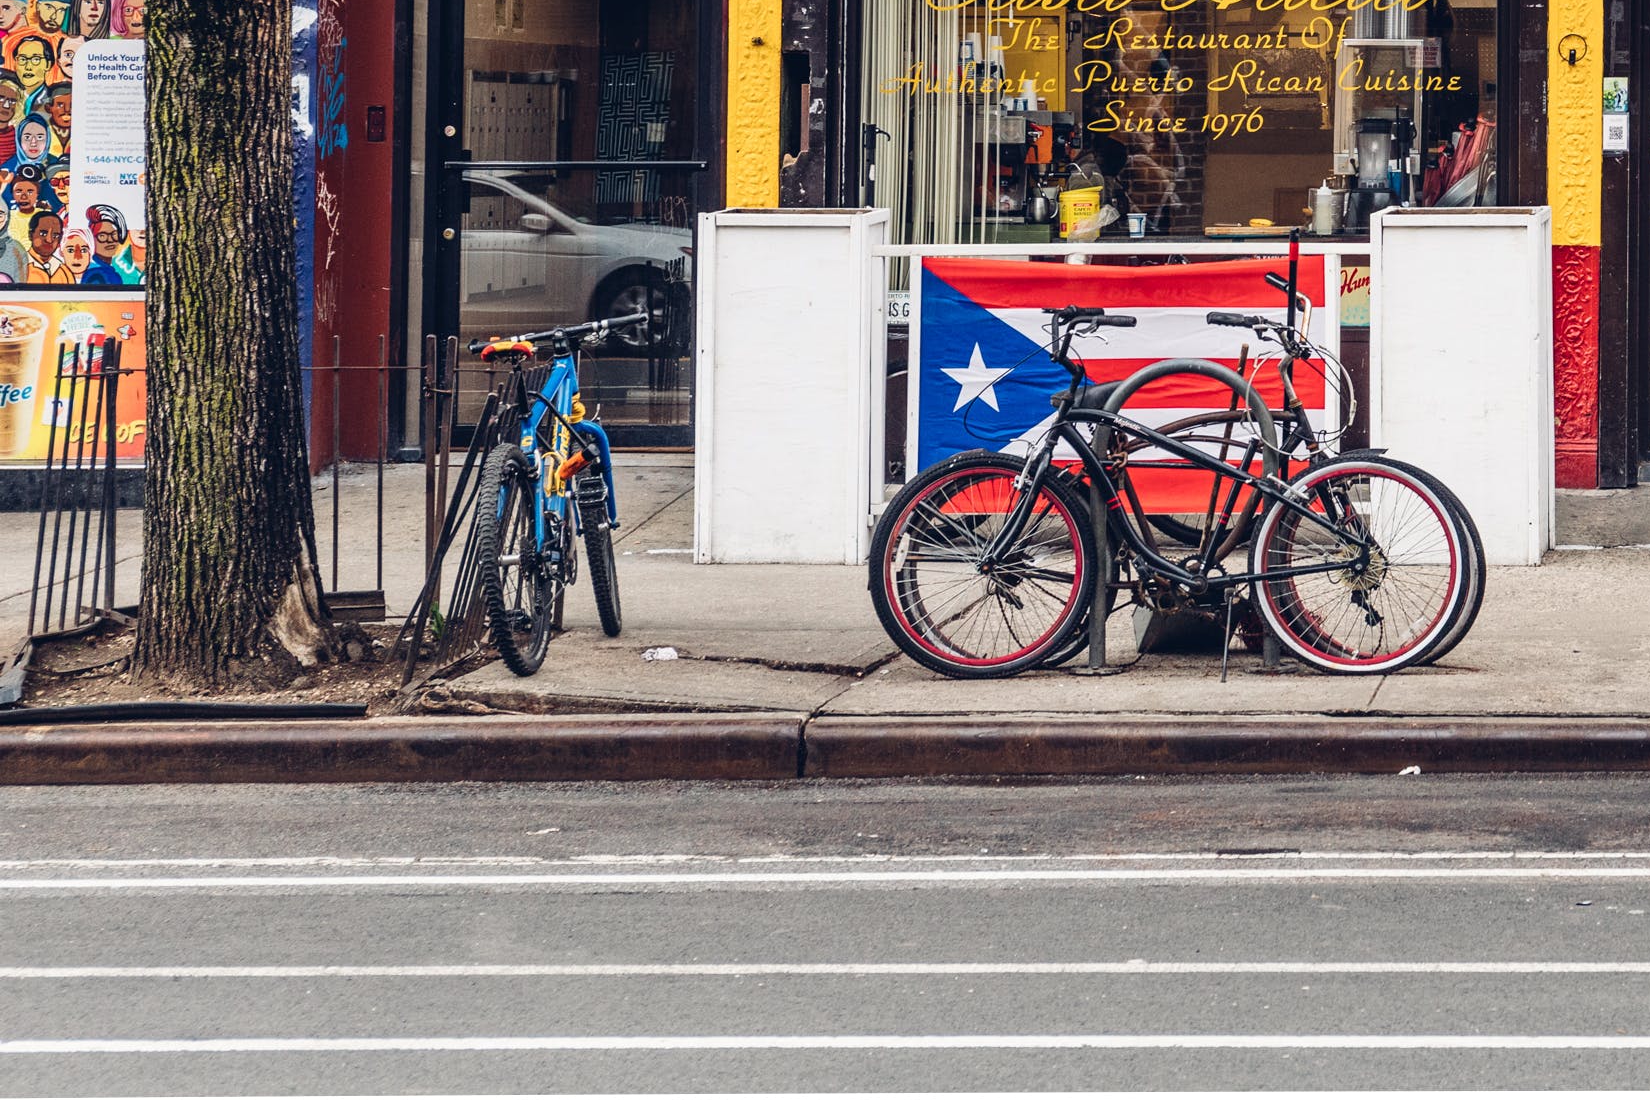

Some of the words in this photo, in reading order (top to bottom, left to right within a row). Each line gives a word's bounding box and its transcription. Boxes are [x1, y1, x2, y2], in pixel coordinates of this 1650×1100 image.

[988, 17, 1060, 50] The
[1083, 17, 1288, 53] Restaurant
[1301, 16, 1353, 59] Of
[88, 72, 116, 80] Before
[99, 63, 127, 71] Health
[879, 60, 1057, 96] Authentic
[1070, 60, 1194, 94] Puerto
[1207, 58, 1327, 95] Rican
[1338, 55, 1463, 92] Cuisine
[1087, 100, 1187, 133] Since
[1200, 106, 1264, 140] 1976
